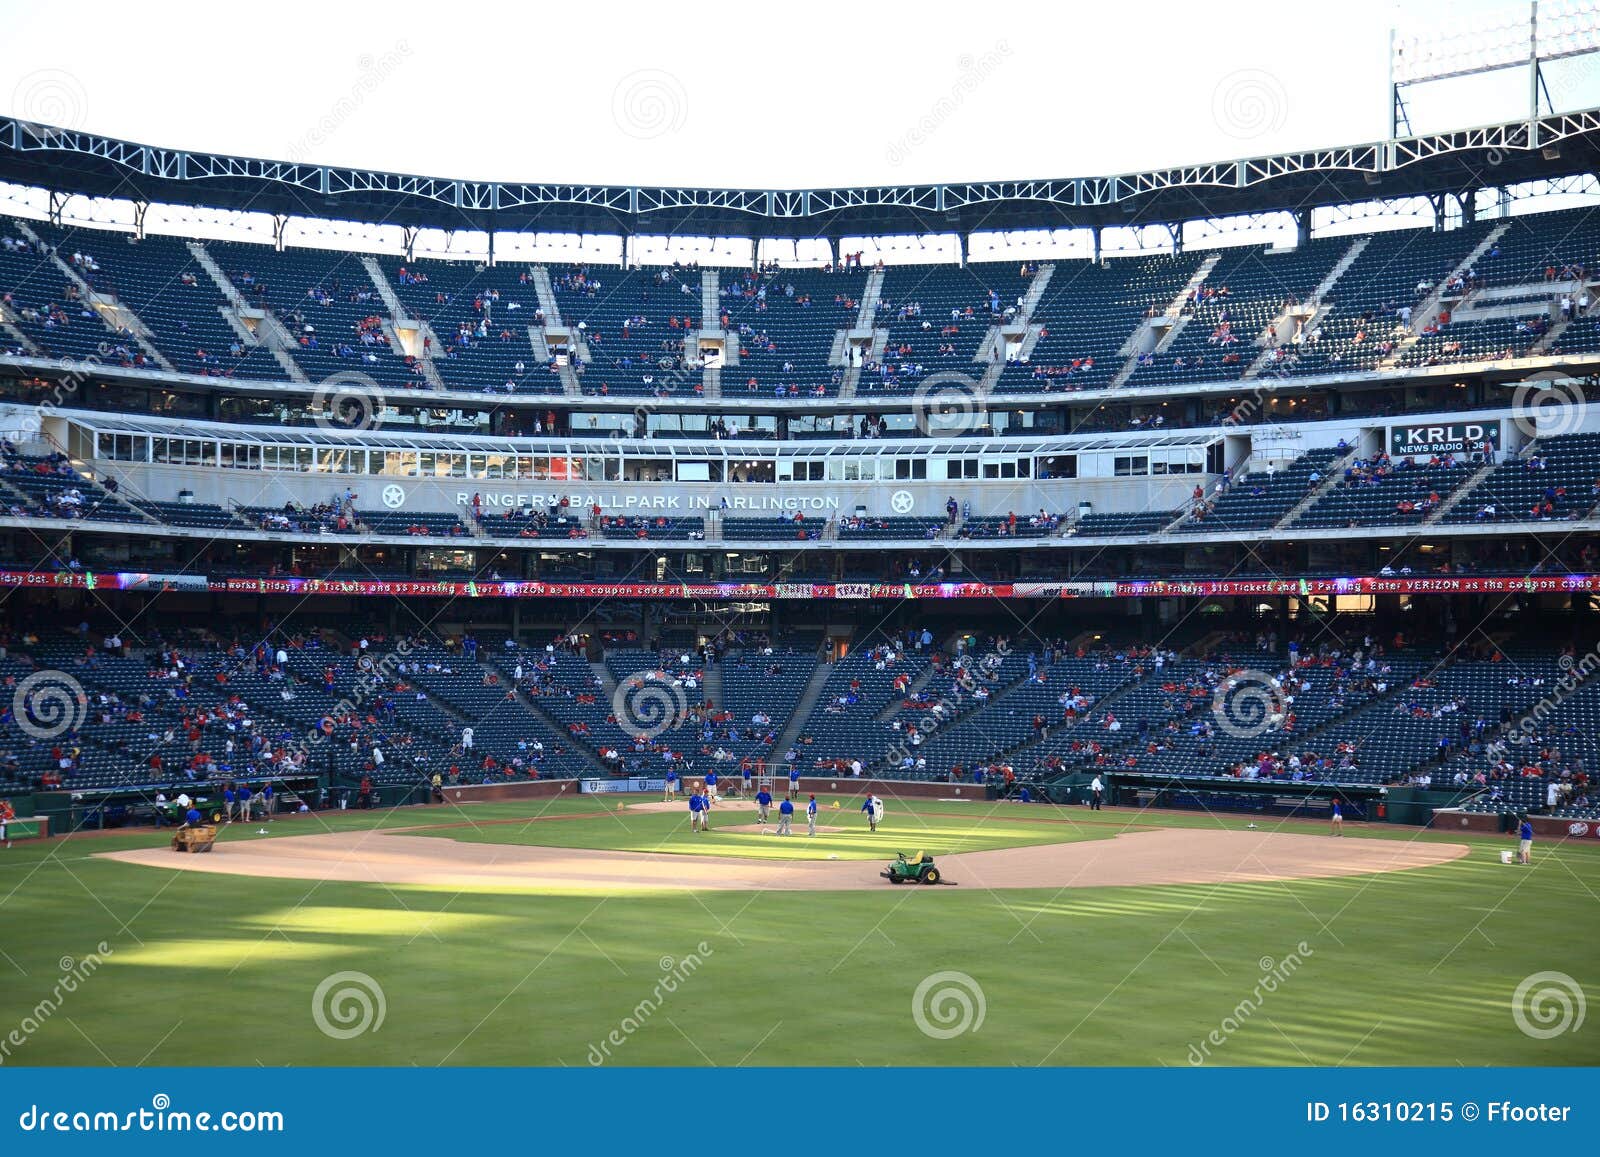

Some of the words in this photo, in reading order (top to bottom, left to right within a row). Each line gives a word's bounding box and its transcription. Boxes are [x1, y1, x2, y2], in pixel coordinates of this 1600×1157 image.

[1408, 425, 1484, 444] KRLD
[1400, 444, 1429, 453] NEWS
[1432, 443, 1463, 452] RADIO
[570, 495, 680, 509] BALLPARK
[688, 496, 710, 509] IN
[497, 584, 545, 594] VERIZON
[568, 586, 586, 594] the
[590, 587, 632, 597] coupon
[637, 586, 665, 594] code
[1370, 582, 1400, 591] Enter
[1406, 580, 1460, 590] VERIZON
[1465, 581, 1479, 589] as
[1483, 580, 1503, 589] the
[1508, 581, 1556, 591] coupon
[1561, 580, 1593, 589] code
